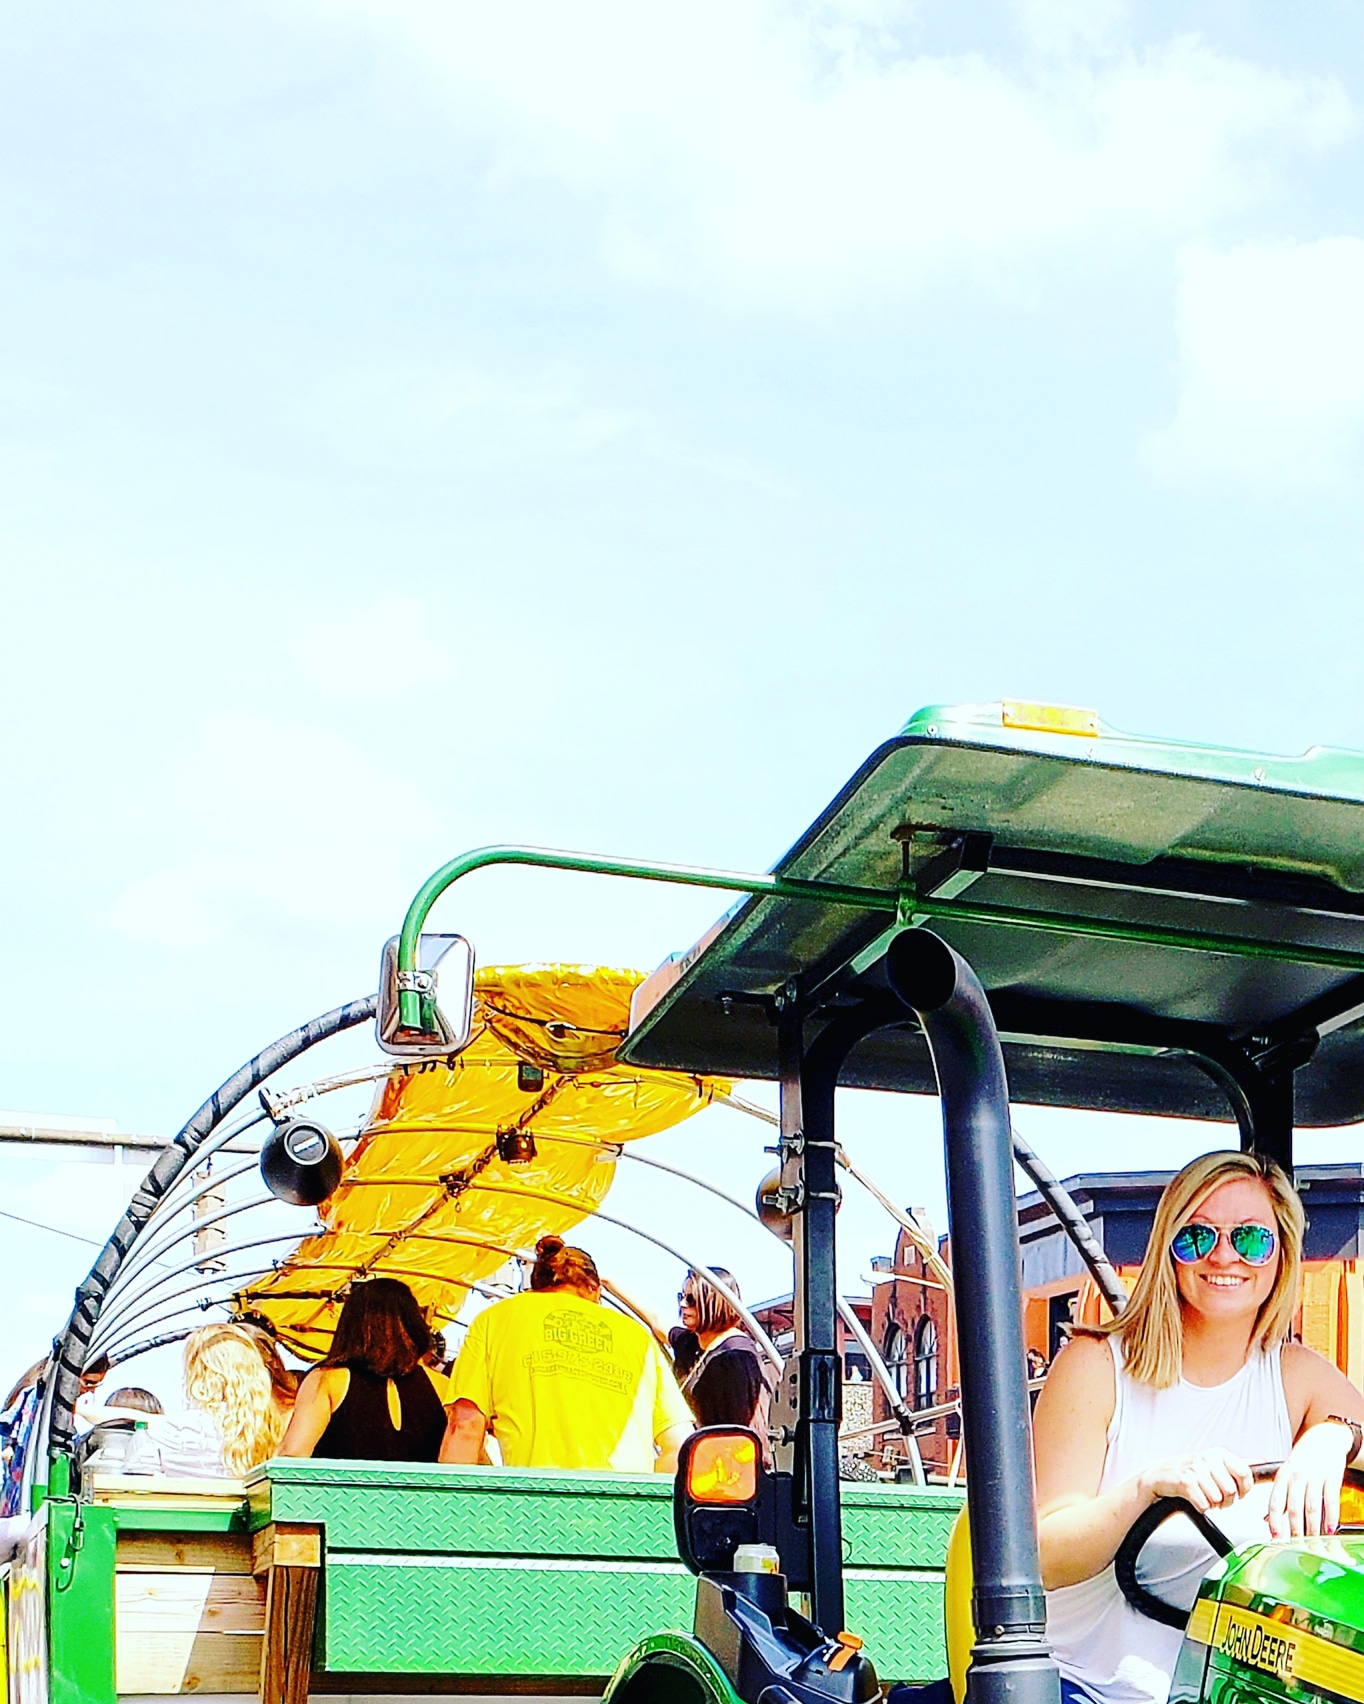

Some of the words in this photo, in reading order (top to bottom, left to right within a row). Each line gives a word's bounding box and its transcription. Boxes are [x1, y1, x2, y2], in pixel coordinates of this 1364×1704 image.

[544, 1327, 567, 1341] BIG
[569, 1329, 613, 1354] GREEN
[1221, 1615, 1252, 1660] JOHN
[1249, 1624, 1296, 1673] DEERE
